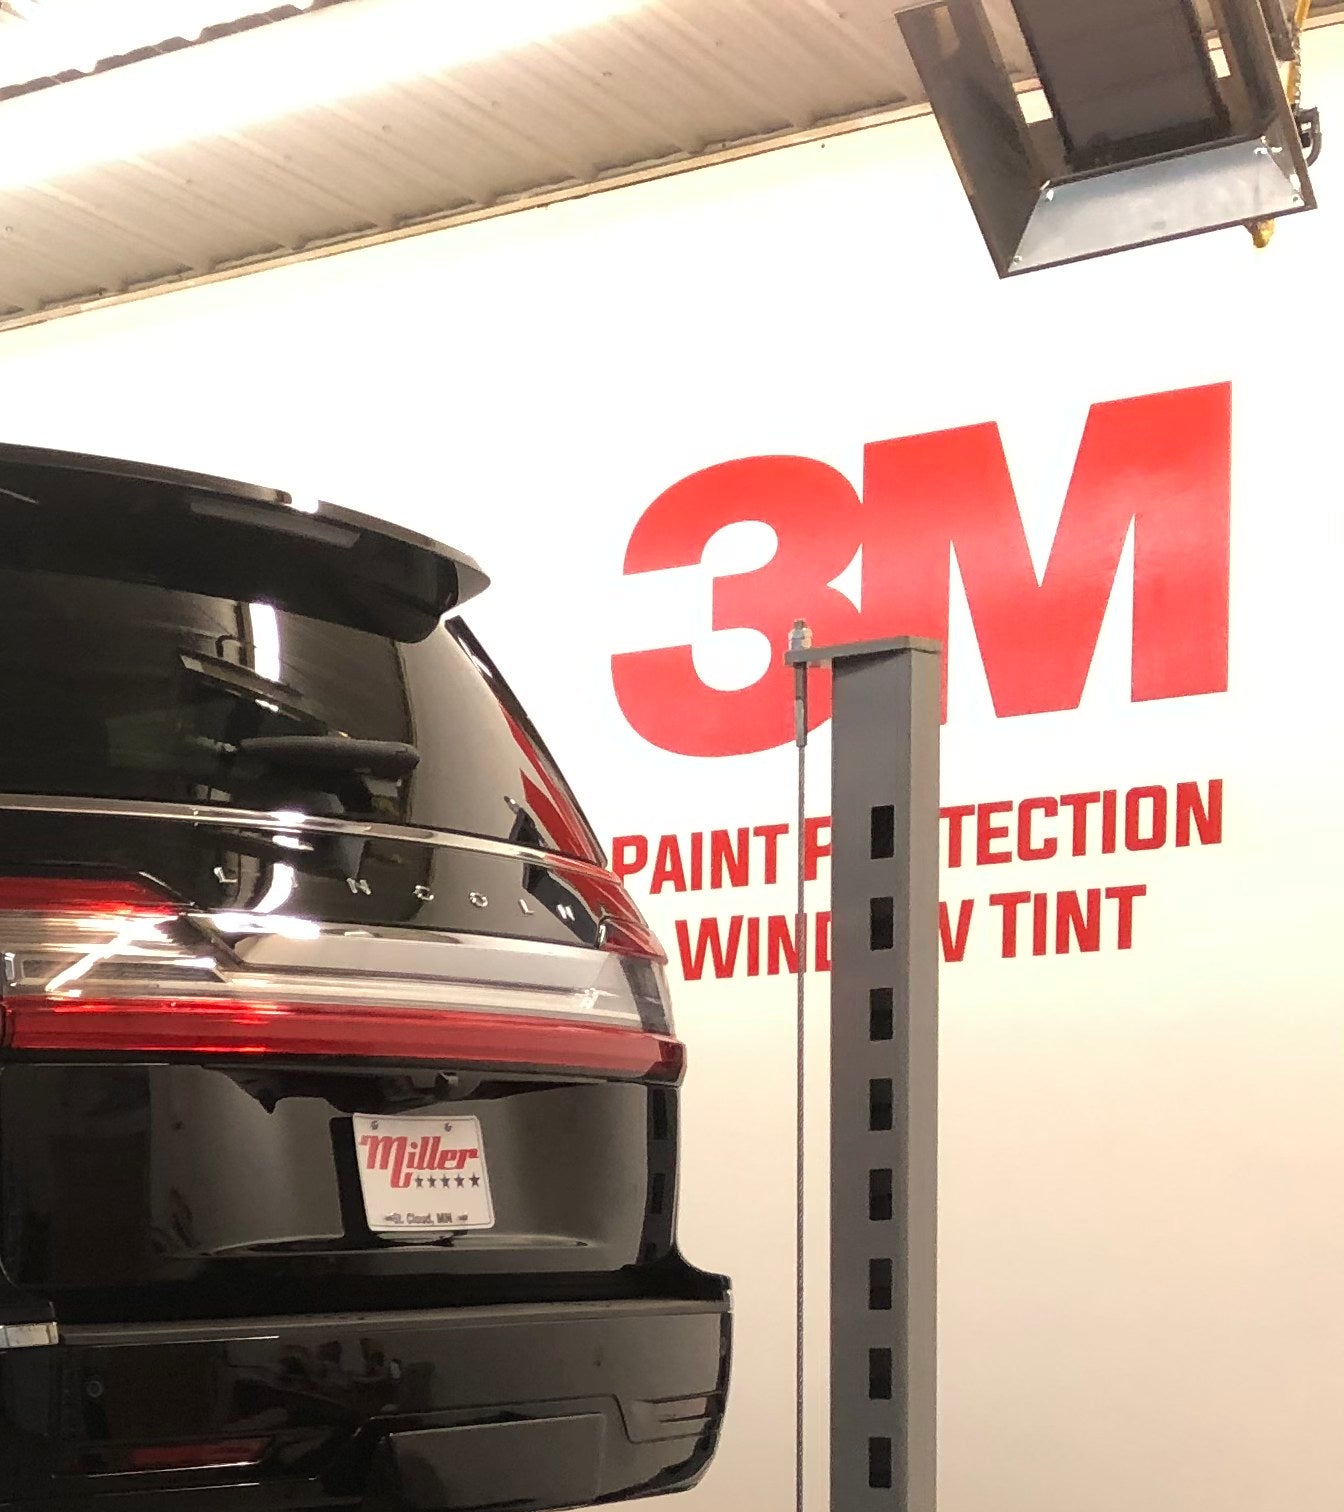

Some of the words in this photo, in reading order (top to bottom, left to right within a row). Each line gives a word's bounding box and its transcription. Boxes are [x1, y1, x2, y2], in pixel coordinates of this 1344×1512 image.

[611, 381, 1232, 757] 3M
[612, 823, 789, 894] PAINT
[804, 778, 1223, 881] PTECTION
[214, 866, 576, 922] LNCOLN
[675, 899, 975, 981] WINW
[989, 884, 1147, 959] TINT
[358, 1134, 480, 1188] Miller
